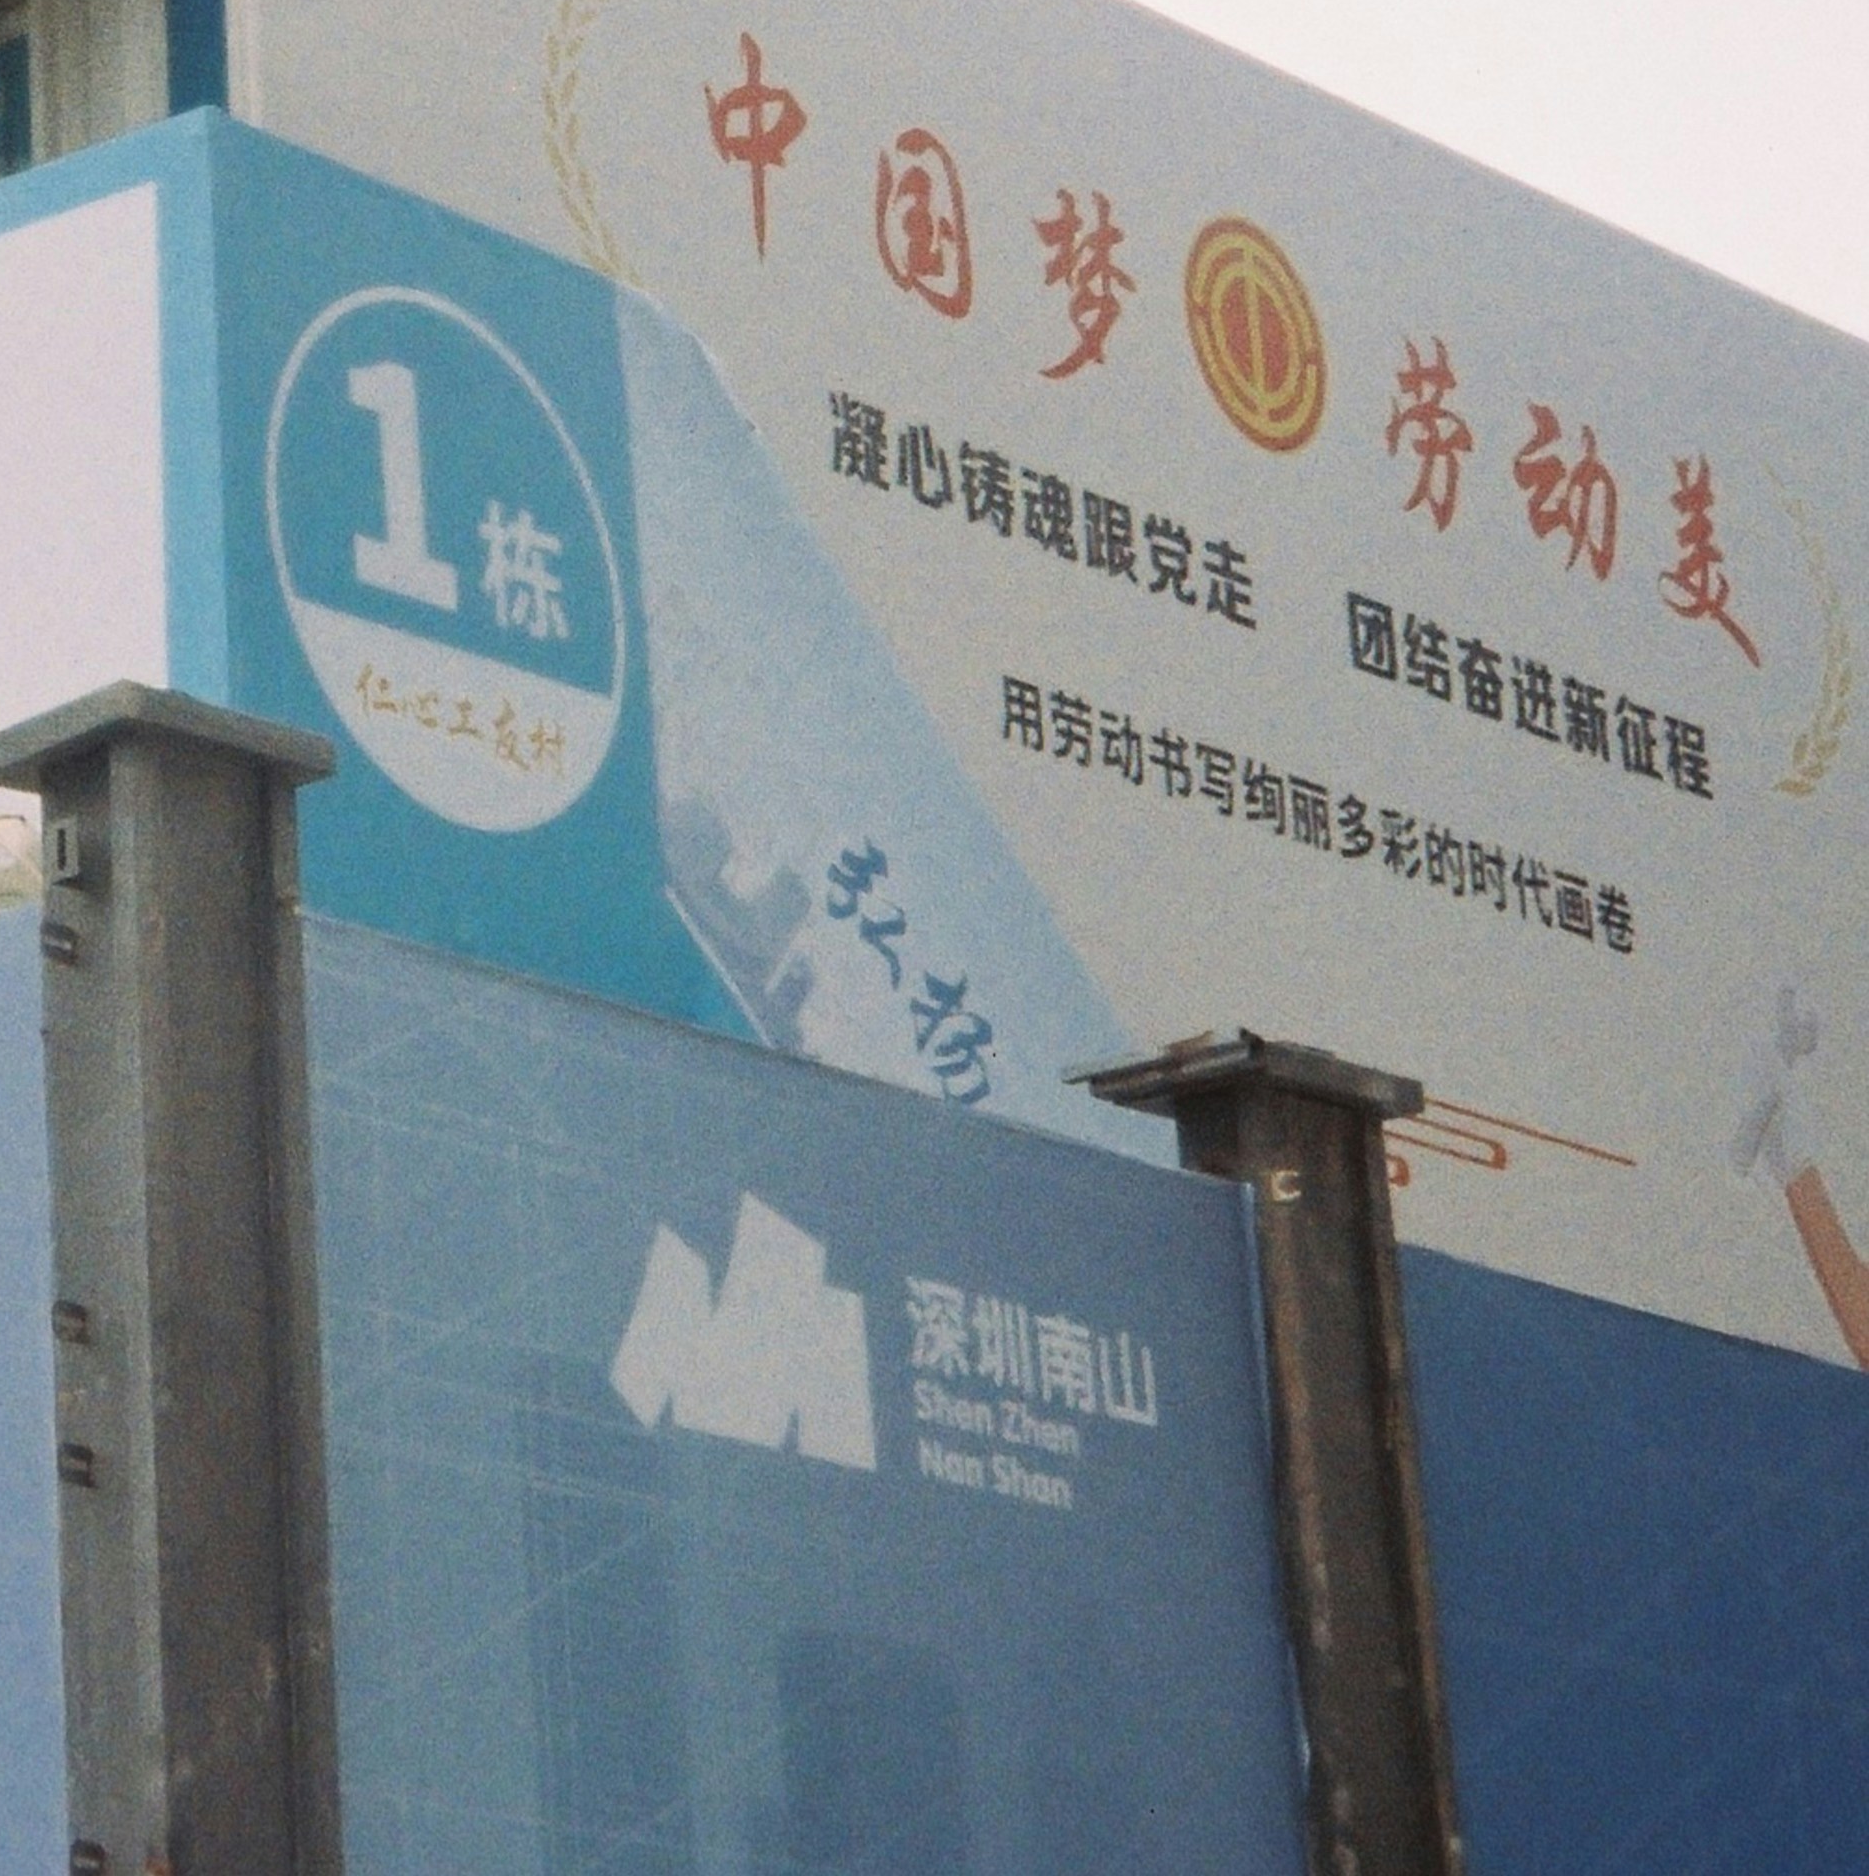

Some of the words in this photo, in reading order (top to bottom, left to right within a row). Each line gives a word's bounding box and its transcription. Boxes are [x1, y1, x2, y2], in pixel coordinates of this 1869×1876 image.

[705, 31, 1135, 380] 中国梦
[1387, 338, 1760, 667] 劳动美
[828, 391, 1257, 630] 凝心铸魂跟党走
[1346, 591, 1714, 800] 团结奋进新征程
[1003, 675, 1636, 954] 用劳动书写绚丽多彩的时代画卷
[906, 1275, 1157, 1426] 深圳南山
[913, 1378, 993, 1436] Shen
[998, 1399, 1080, 1457] Zhen
[918, 1437, 985, 1489] Nan
[992, 1452, 1073, 1510] Shan
